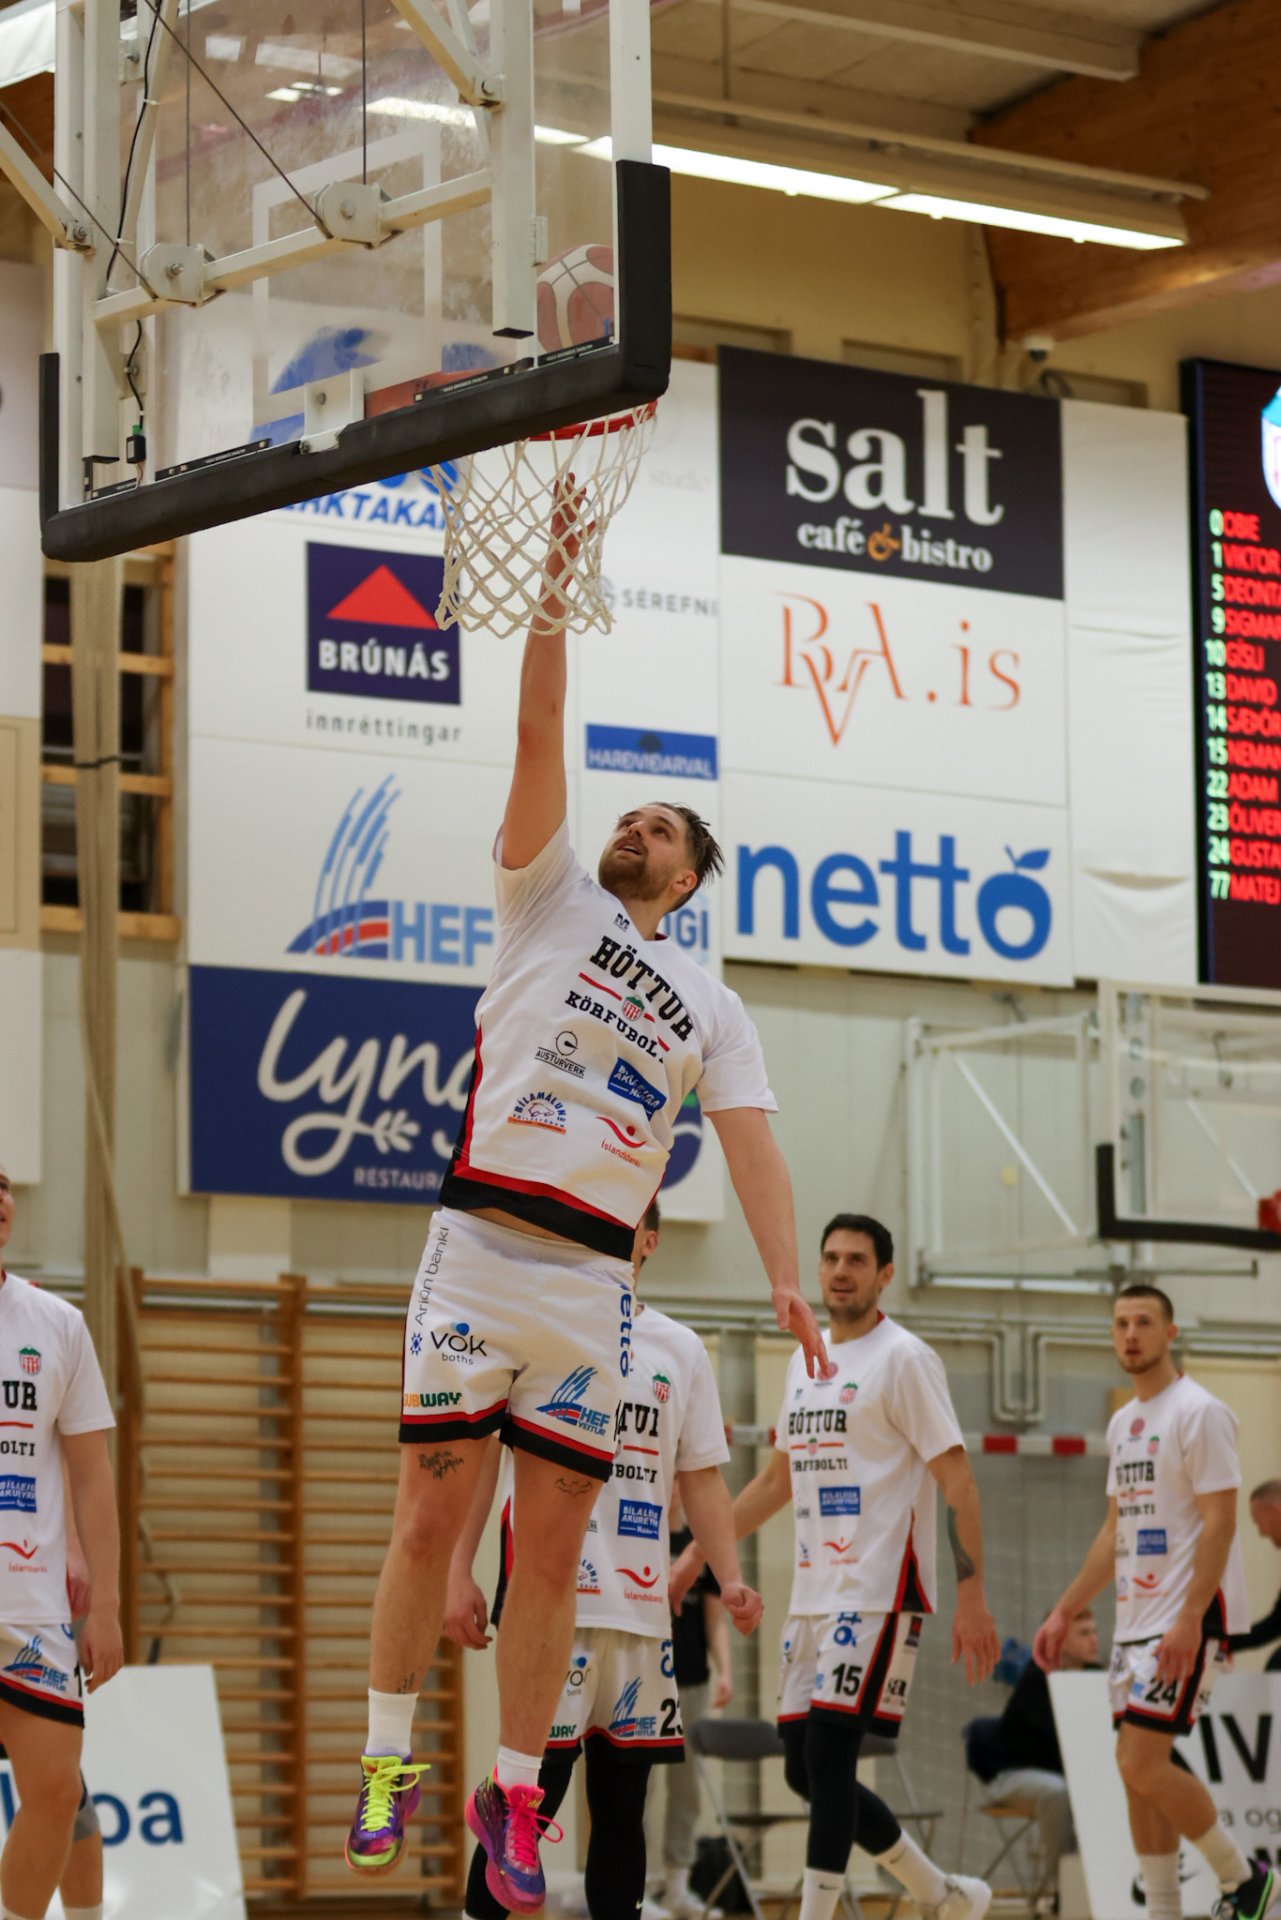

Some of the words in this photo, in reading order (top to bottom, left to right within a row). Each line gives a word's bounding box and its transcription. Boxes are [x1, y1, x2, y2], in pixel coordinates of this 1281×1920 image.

[786, 388, 1005, 527] salt
[1209, 509, 1224, 537] 0
[797, 516, 866, 554] café
[867, 523, 901, 561] &
[901, 525, 994, 573] bistro
[1211, 541, 1223, 568] 1
[1211, 573, 1225, 601] 5
[1211, 606, 1226, 634] 9
[318, 637, 450, 681] BRÚNÁS
[1204, 639, 1227, 667] 10
[1205, 671, 1227, 700] 13
[306, 708, 461, 746] innréttingar
[1206, 704, 1228, 733] 14
[1206, 736, 1229, 765] 15
[1206, 769, 1229, 799] 22
[1207, 835, 1231, 865] 24
[1208, 869, 1231, 900] 77
[392, 901, 494, 967] HEF
[589, 935, 695, 1042] HÖTTUR
[564, 990, 665, 1064] KÖRFUBOL
[535, 1050, 585, 1077] AUSTURVERK
[353, 1166, 444, 1190] RESTAUR
[414, 1278, 434, 1326] Arion
[424, 1226, 450, 1275] banki
[441, 1351, 475, 1366] baths
[579, 1407, 611, 1429] HEF
[832, 1663, 863, 1696] 15
[1145, 1677, 1178, 1707] 24
[659, 1698, 683, 1738] 2
